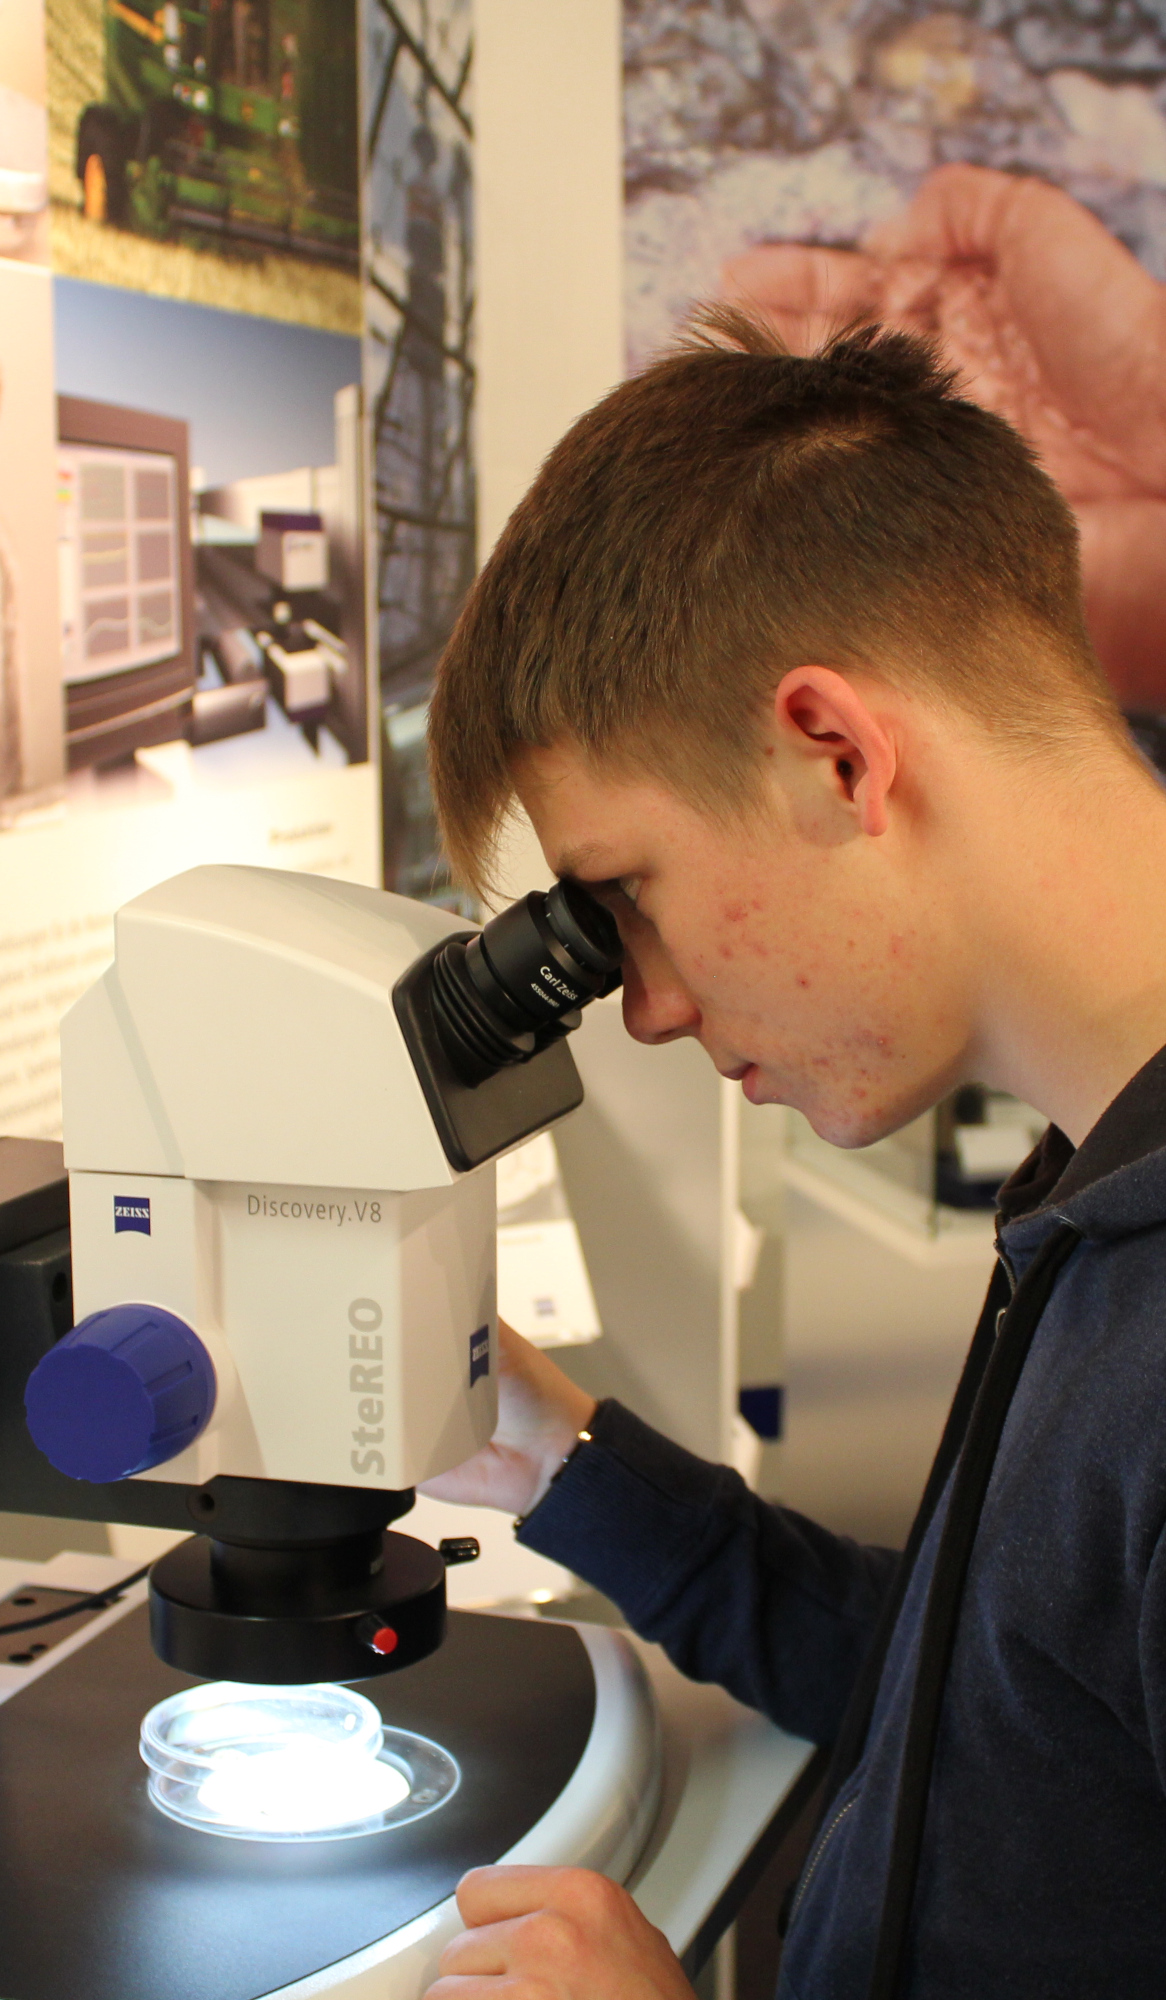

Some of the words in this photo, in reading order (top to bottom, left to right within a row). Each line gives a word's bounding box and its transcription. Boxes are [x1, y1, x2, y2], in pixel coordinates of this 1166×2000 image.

[540, 966, 561, 987] Carl
[556, 983, 578, 1000] Zeiss
[114, 1206, 150, 1218] ZEISS
[247, 1194, 382, 1226] Discovery.V8
[347, 1297, 385, 1477] SteREO
